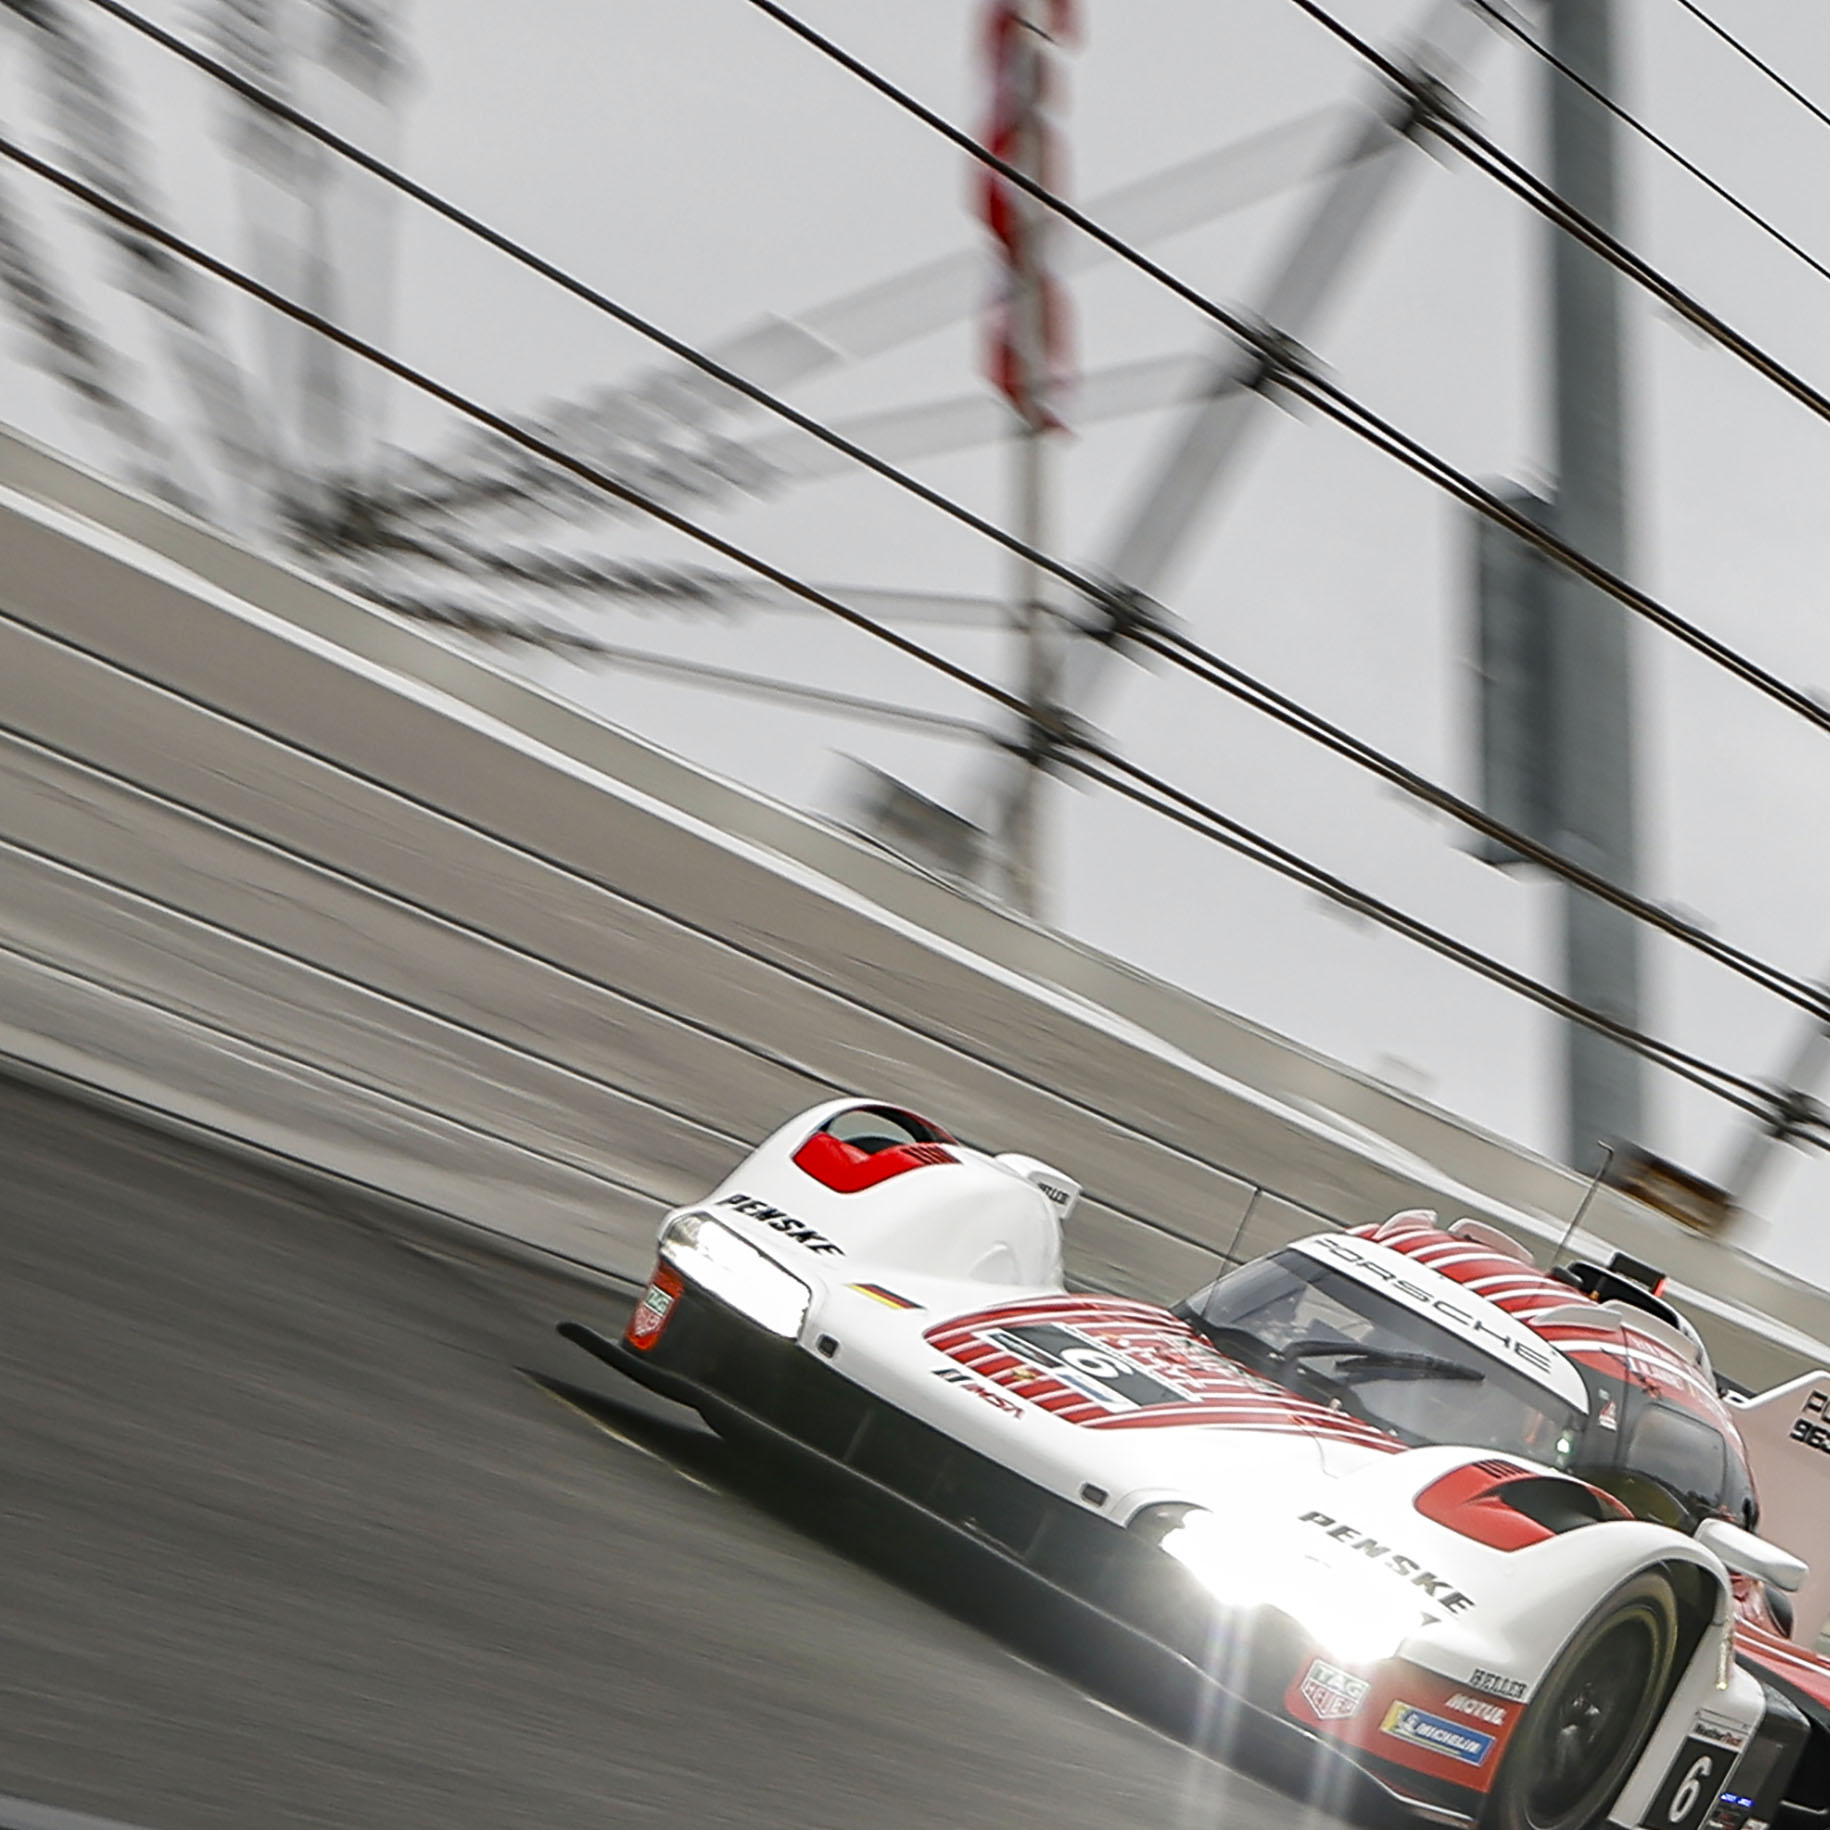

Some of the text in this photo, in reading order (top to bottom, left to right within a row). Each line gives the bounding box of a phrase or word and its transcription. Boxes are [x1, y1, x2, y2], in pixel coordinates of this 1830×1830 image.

[717, 1193, 846, 1259] PENSKE
[1315, 1236, 1553, 1374] PORSCHE
[1059, 1348, 1134, 1379] 6
[1298, 1510, 1476, 1615] PENSKE
[1312, 1667, 1364, 1698] TAG
[1445, 1693, 1508, 1726] MOTUL
[1415, 1722, 1483, 1754] MICHELIN
[1668, 1756, 1713, 1824] 6
